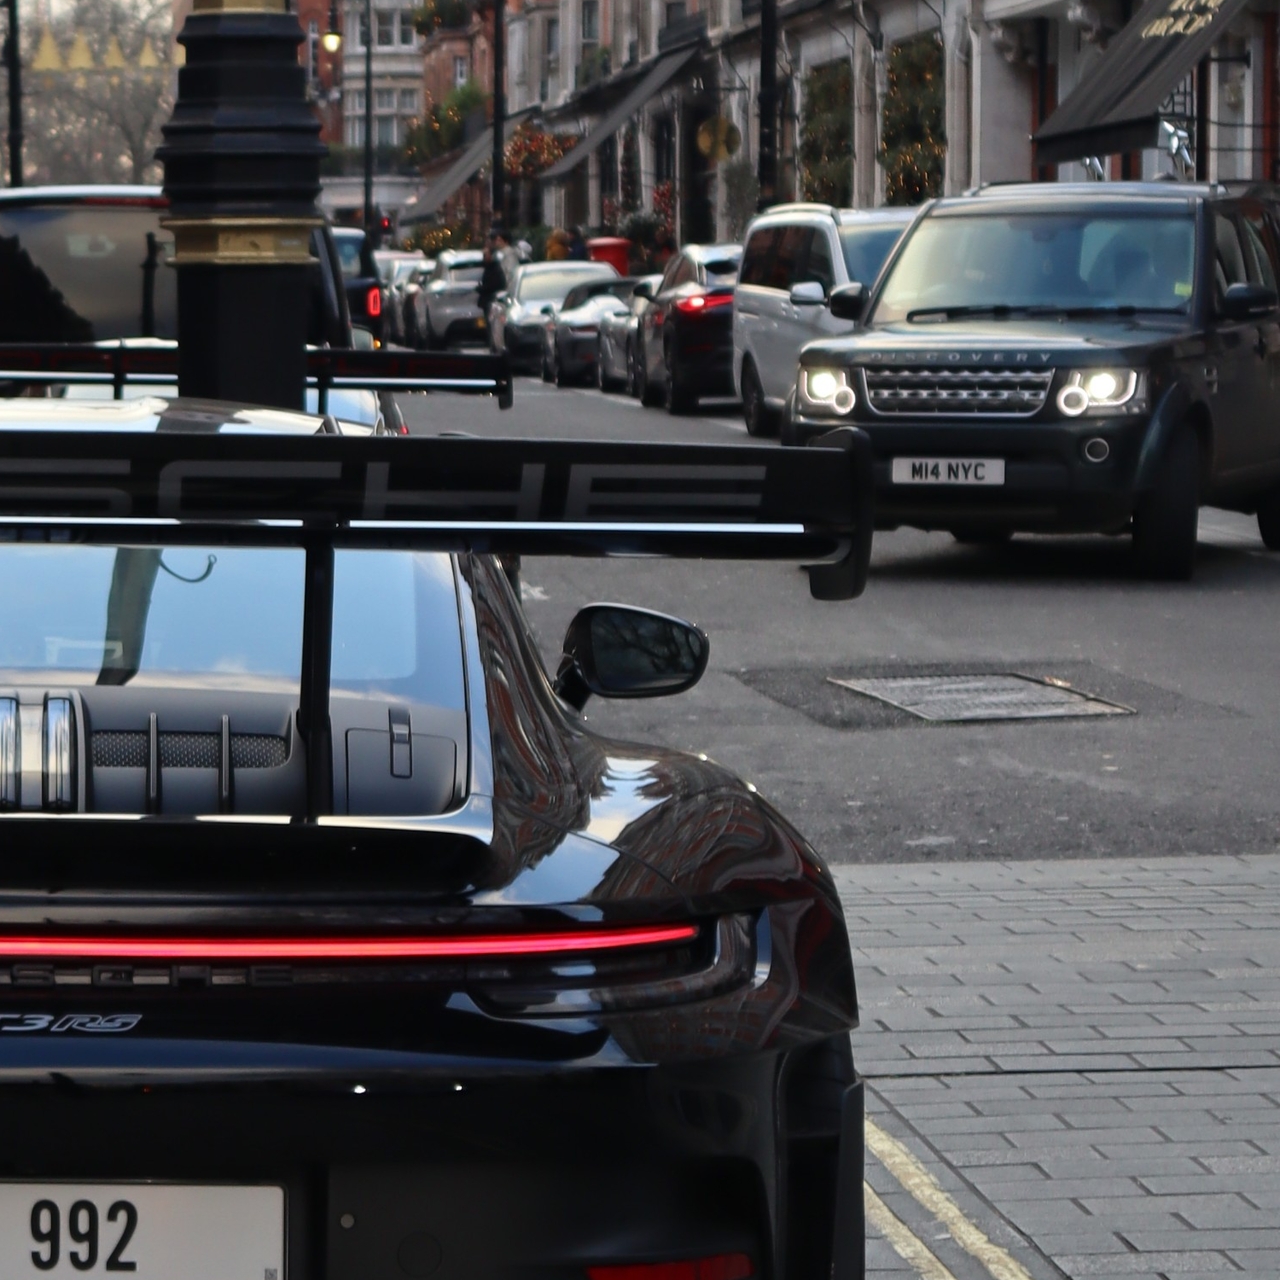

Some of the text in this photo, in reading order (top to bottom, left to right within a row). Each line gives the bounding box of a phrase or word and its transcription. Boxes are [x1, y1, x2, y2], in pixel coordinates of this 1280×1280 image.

[870, 352, 1052, 363] DISCOVERY
[947, 461, 986, 481] NYC
[30, 1199, 138, 1272] 992
